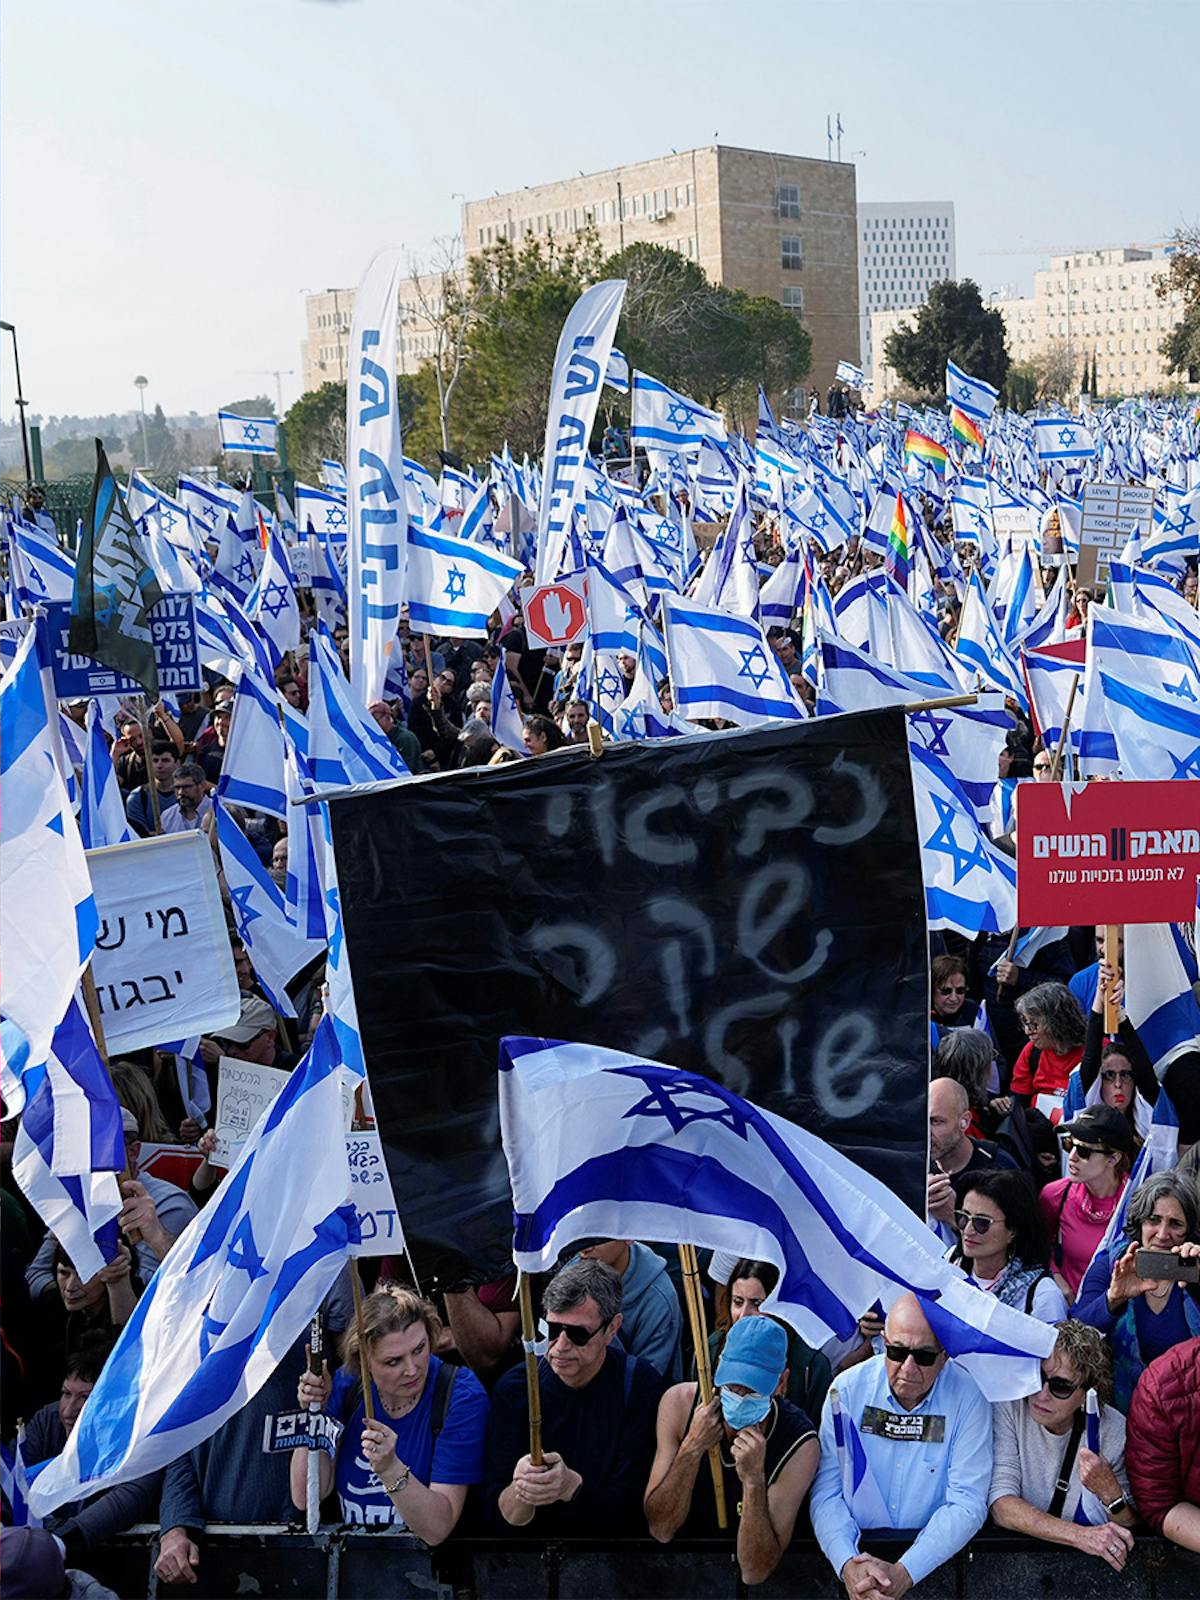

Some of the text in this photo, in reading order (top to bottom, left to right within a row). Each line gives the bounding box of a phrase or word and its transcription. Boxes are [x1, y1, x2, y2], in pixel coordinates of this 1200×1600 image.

[545, 335, 601, 550] יש עתיד
[358, 329, 400, 640] יש עתיד
[152, 620, 192, 641] 973
[1033, 829, 1200, 859] מאבק הנשים
[1048, 867, 1185, 885] לא תפגעו בזכויות שלנו
[144, 906, 189, 939] מי
